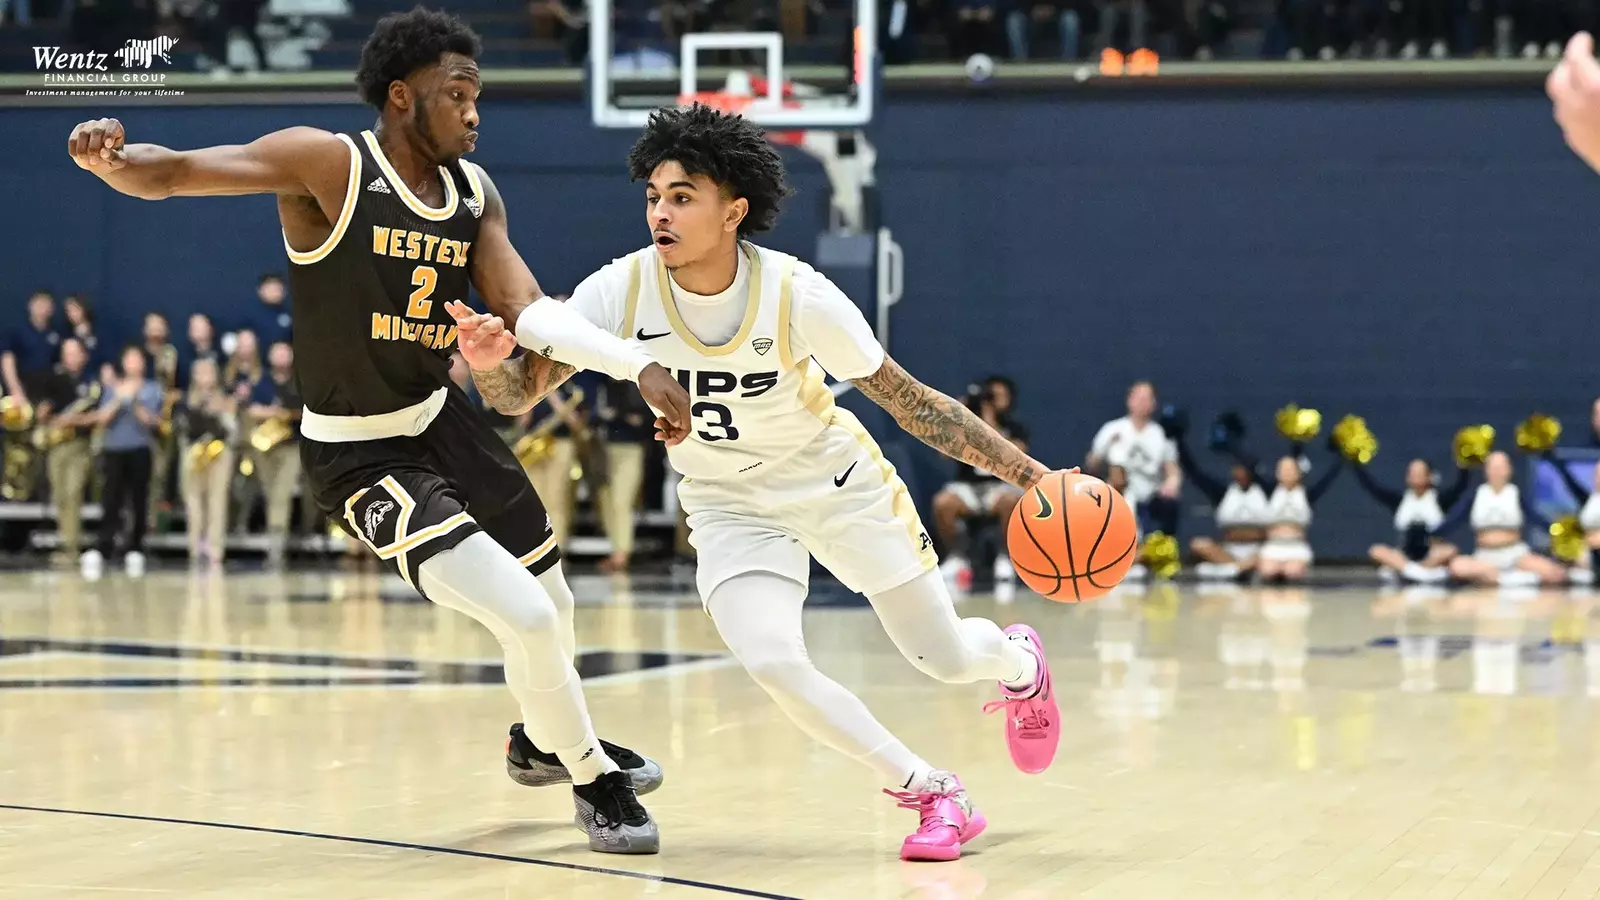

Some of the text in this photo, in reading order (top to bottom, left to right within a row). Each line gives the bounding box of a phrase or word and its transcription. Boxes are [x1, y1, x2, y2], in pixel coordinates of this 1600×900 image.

[405, 265, 438, 319] 2
[663, 366, 779, 398] IPS
[691, 401, 740, 442] 3
